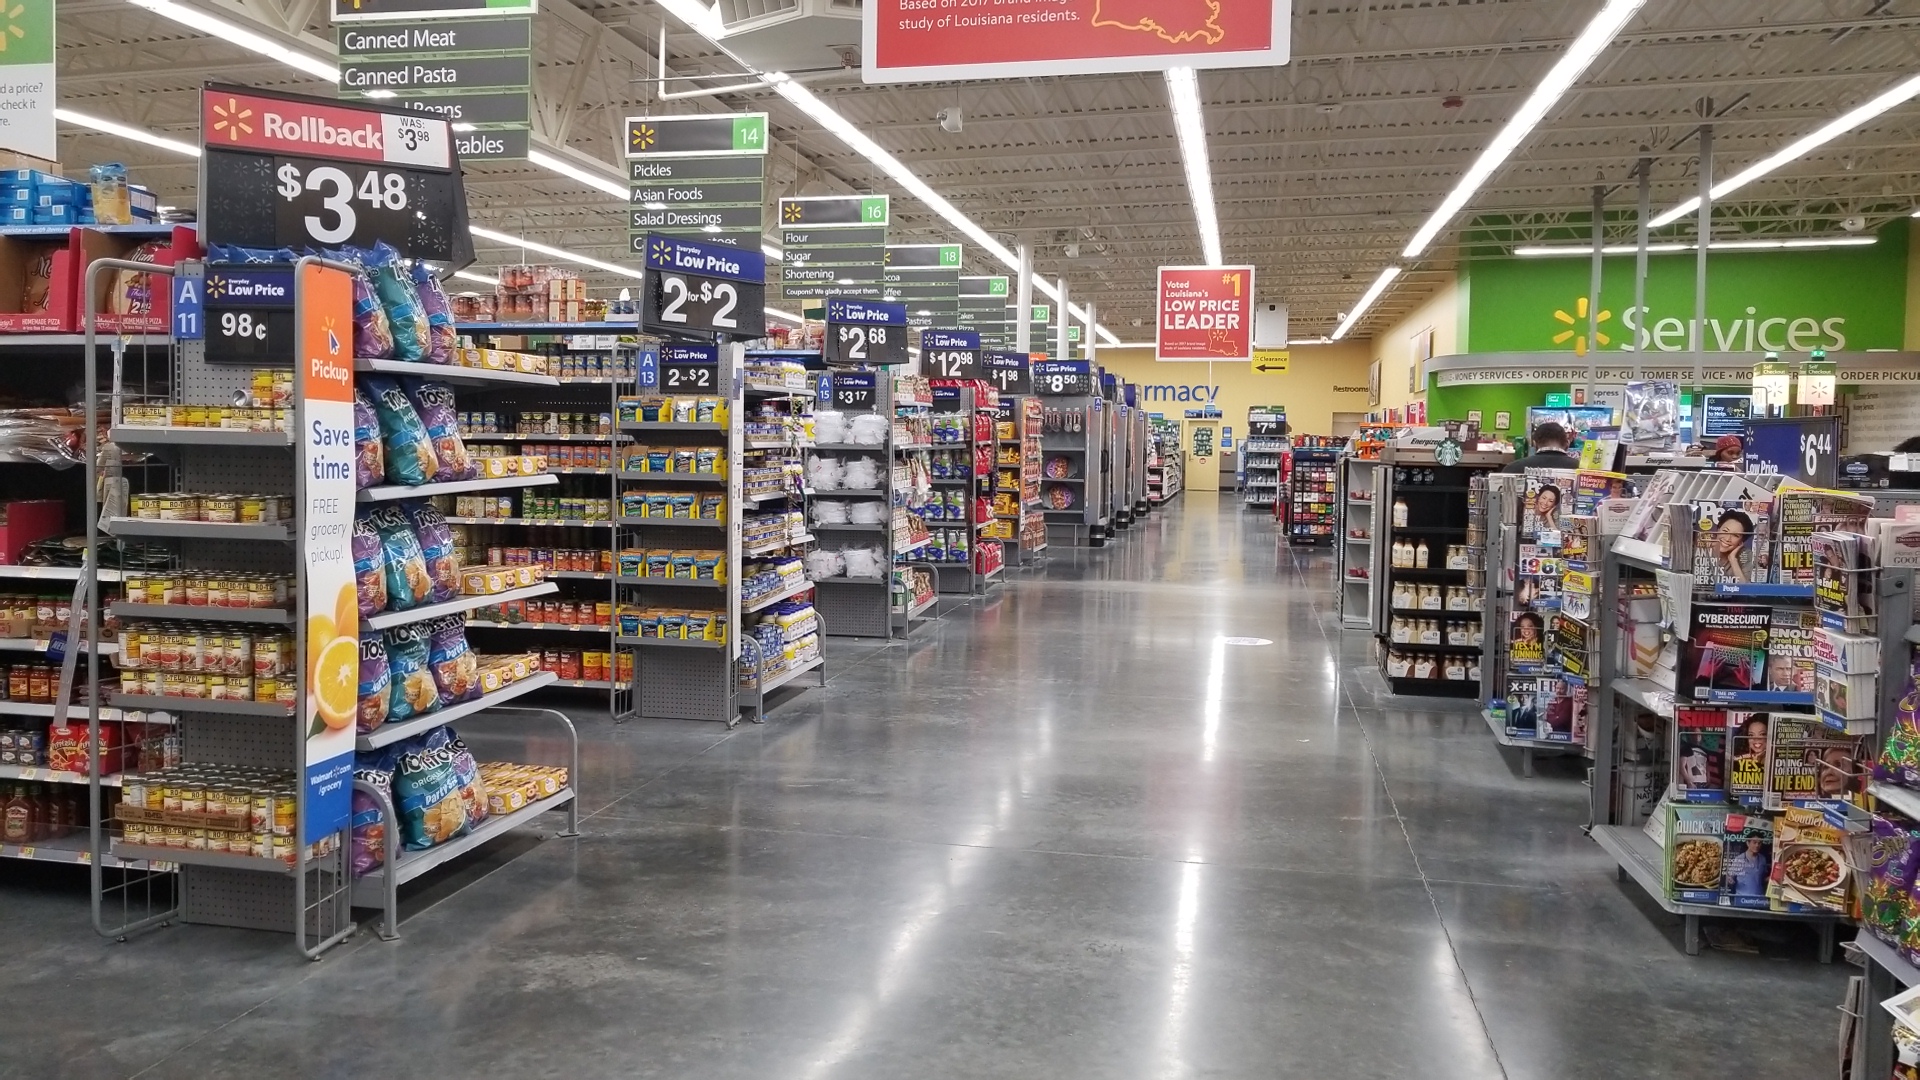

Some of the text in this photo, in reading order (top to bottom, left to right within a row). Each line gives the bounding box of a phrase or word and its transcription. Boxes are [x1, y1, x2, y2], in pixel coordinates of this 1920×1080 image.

[900, 0, 936, 10] Based
[899, 9, 1080, 32] study of Louisiana residents.
[344, 29, 456, 50] Canned Meat
[344, 65, 457, 86] Canned Pasta
[16, 82, 43, 96] price?
[1, 98, 36, 110] check it
[400, 117, 425, 129] WAS:
[263, 112, 384, 150] Rollback
[740, 127, 759, 145] 14
[633, 164, 672, 178] Pickles
[633, 187, 703, 202] Asian Foods
[633, 211, 722, 226] Salad Dressings
[867, 205, 882, 219] 16
[785, 232, 809, 243] Flour
[676, 244, 702, 256] Everyday
[944, 251, 957, 262] 18
[675, 251, 741, 275] Low Price
[785, 251, 812, 263] Sugar
[785, 269, 835, 281] Shortening
[228, 283, 285, 296] Low Price
[992, 282, 1004, 292] 20
[1165, 280, 1189, 289] Voted
[1221, 273, 1241, 297] #1
[179, 280, 197, 304] A
[786, 288, 814, 297] Coupons?
[824, 287, 842, 297] gladly
[842, 287, 862, 296] accept
[862, 287, 880, 295] them.
[1165, 289, 1209, 298] Louisiana's
[661, 277, 738, 329] 2 for $2
[1164, 299, 1240, 312] LOW PRICE
[846, 309, 889, 322] Low Price
[1036, 309, 1046, 318] 22
[149, 317, 162, 325] PIZZA
[178, 312, 196, 334] 11
[1164, 313, 1240, 330] LEADER
[1068, 330, 1077, 338] 24
[1620, 305, 1846, 352] Services
[935, 338, 968, 348] Low Price
[642, 353, 654, 367] A
[674, 352, 708, 360] Low Price
[992, 358, 1019, 367] Low Price
[311, 358, 349, 386] Pickup
[1045, 365, 1077, 373] Low Price
[1479, 370, 1523, 380] SERVICES
[1532, 370, 1569, 379] ORDER
[1619, 370, 1678, 380] CUTOMER
[1681, 370, 1726, 380] SEVICE
[641, 371, 655, 384] 13
[668, 368, 680, 386] 2
[821, 377, 829, 388] A
[1840, 371, 1880, 381] ORDER
[820, 390, 830, 400] 15
[1144, 384, 1220, 402] rmacy
[1332, 385, 1370, 393] Restrooms
[1708, 405, 1724, 413] Happy
[312, 419, 350, 446] Save
[312, 454, 350, 480] time
[1645, 457, 1674, 465] Energizer
[1745, 460, 1778, 475] Low Price
[213, 501, 235, 509] RO-TEL
[312, 498, 339, 515] FREE
[311, 522, 348, 541] grocery
[310, 545, 344, 567] pickup!
[1784, 552, 1804, 568] THE
[1694, 576, 1708, 585] HER
[1722, 584, 1740, 593] People
[1698, 613, 1770, 625] CYBERSECURITY
[1563, 621, 1581, 635] CSI
[1813, 638, 1834, 653] Brainy
[1813, 648, 1839, 663] Puzzles
[1738, 759, 1762, 773] YES,
[1775, 758, 1803, 768] DYING
[1774, 775, 1793, 791] THE
[424, 785, 449, 806] Party
[1676, 820, 1705, 834] QUICK
